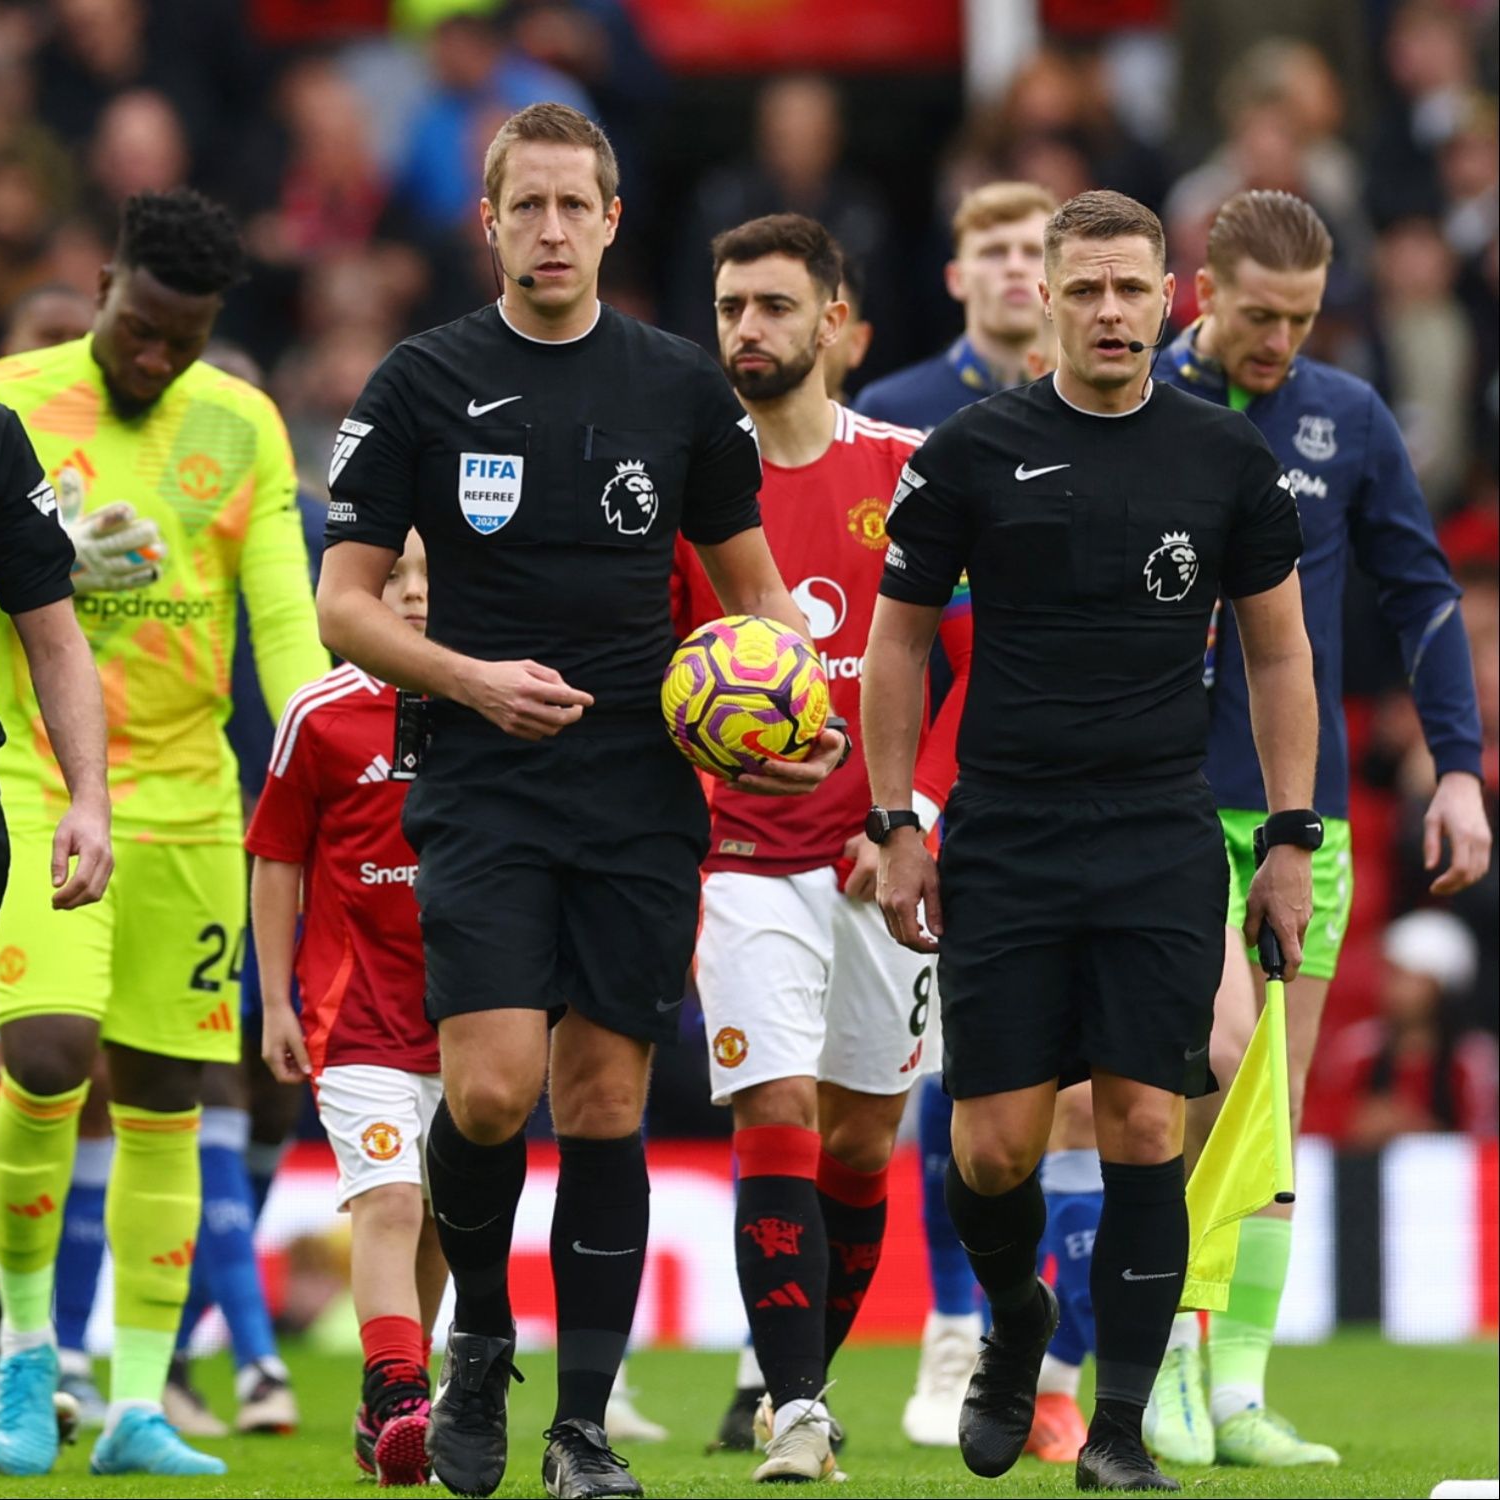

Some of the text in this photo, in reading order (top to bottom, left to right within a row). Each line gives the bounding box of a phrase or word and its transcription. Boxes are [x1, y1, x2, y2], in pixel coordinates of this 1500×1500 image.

[465, 459, 516, 480] FIFA
[464, 490, 515, 503] REFEREE
[475, 517, 499, 527] 2024
[909, 965, 932, 1037] 8
